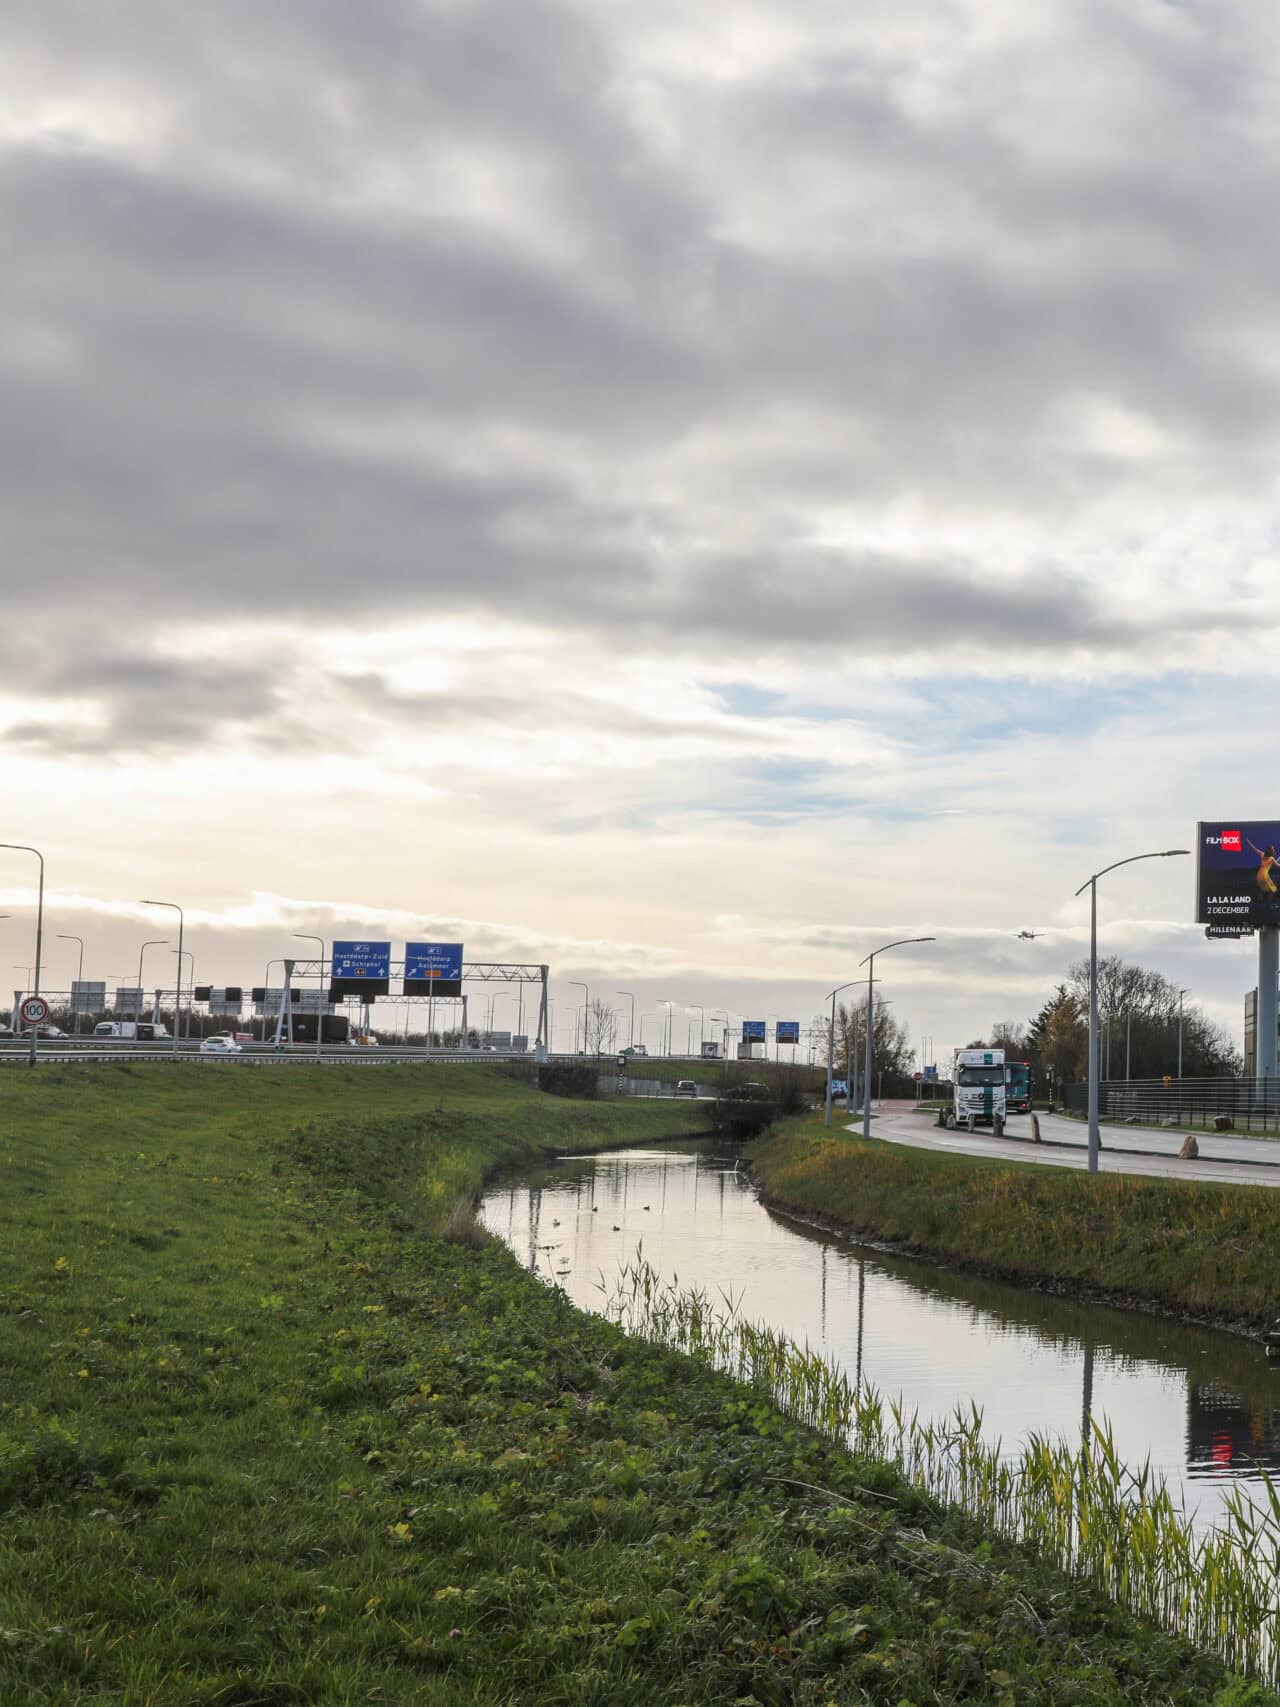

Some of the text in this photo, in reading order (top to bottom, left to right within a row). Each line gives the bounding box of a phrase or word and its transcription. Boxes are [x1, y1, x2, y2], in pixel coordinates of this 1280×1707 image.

[1207, 895, 1252, 904] LA LA LAND
[1212, 906, 1250, 914] DECEMBER
[26, 1004, 44, 1016] 100
